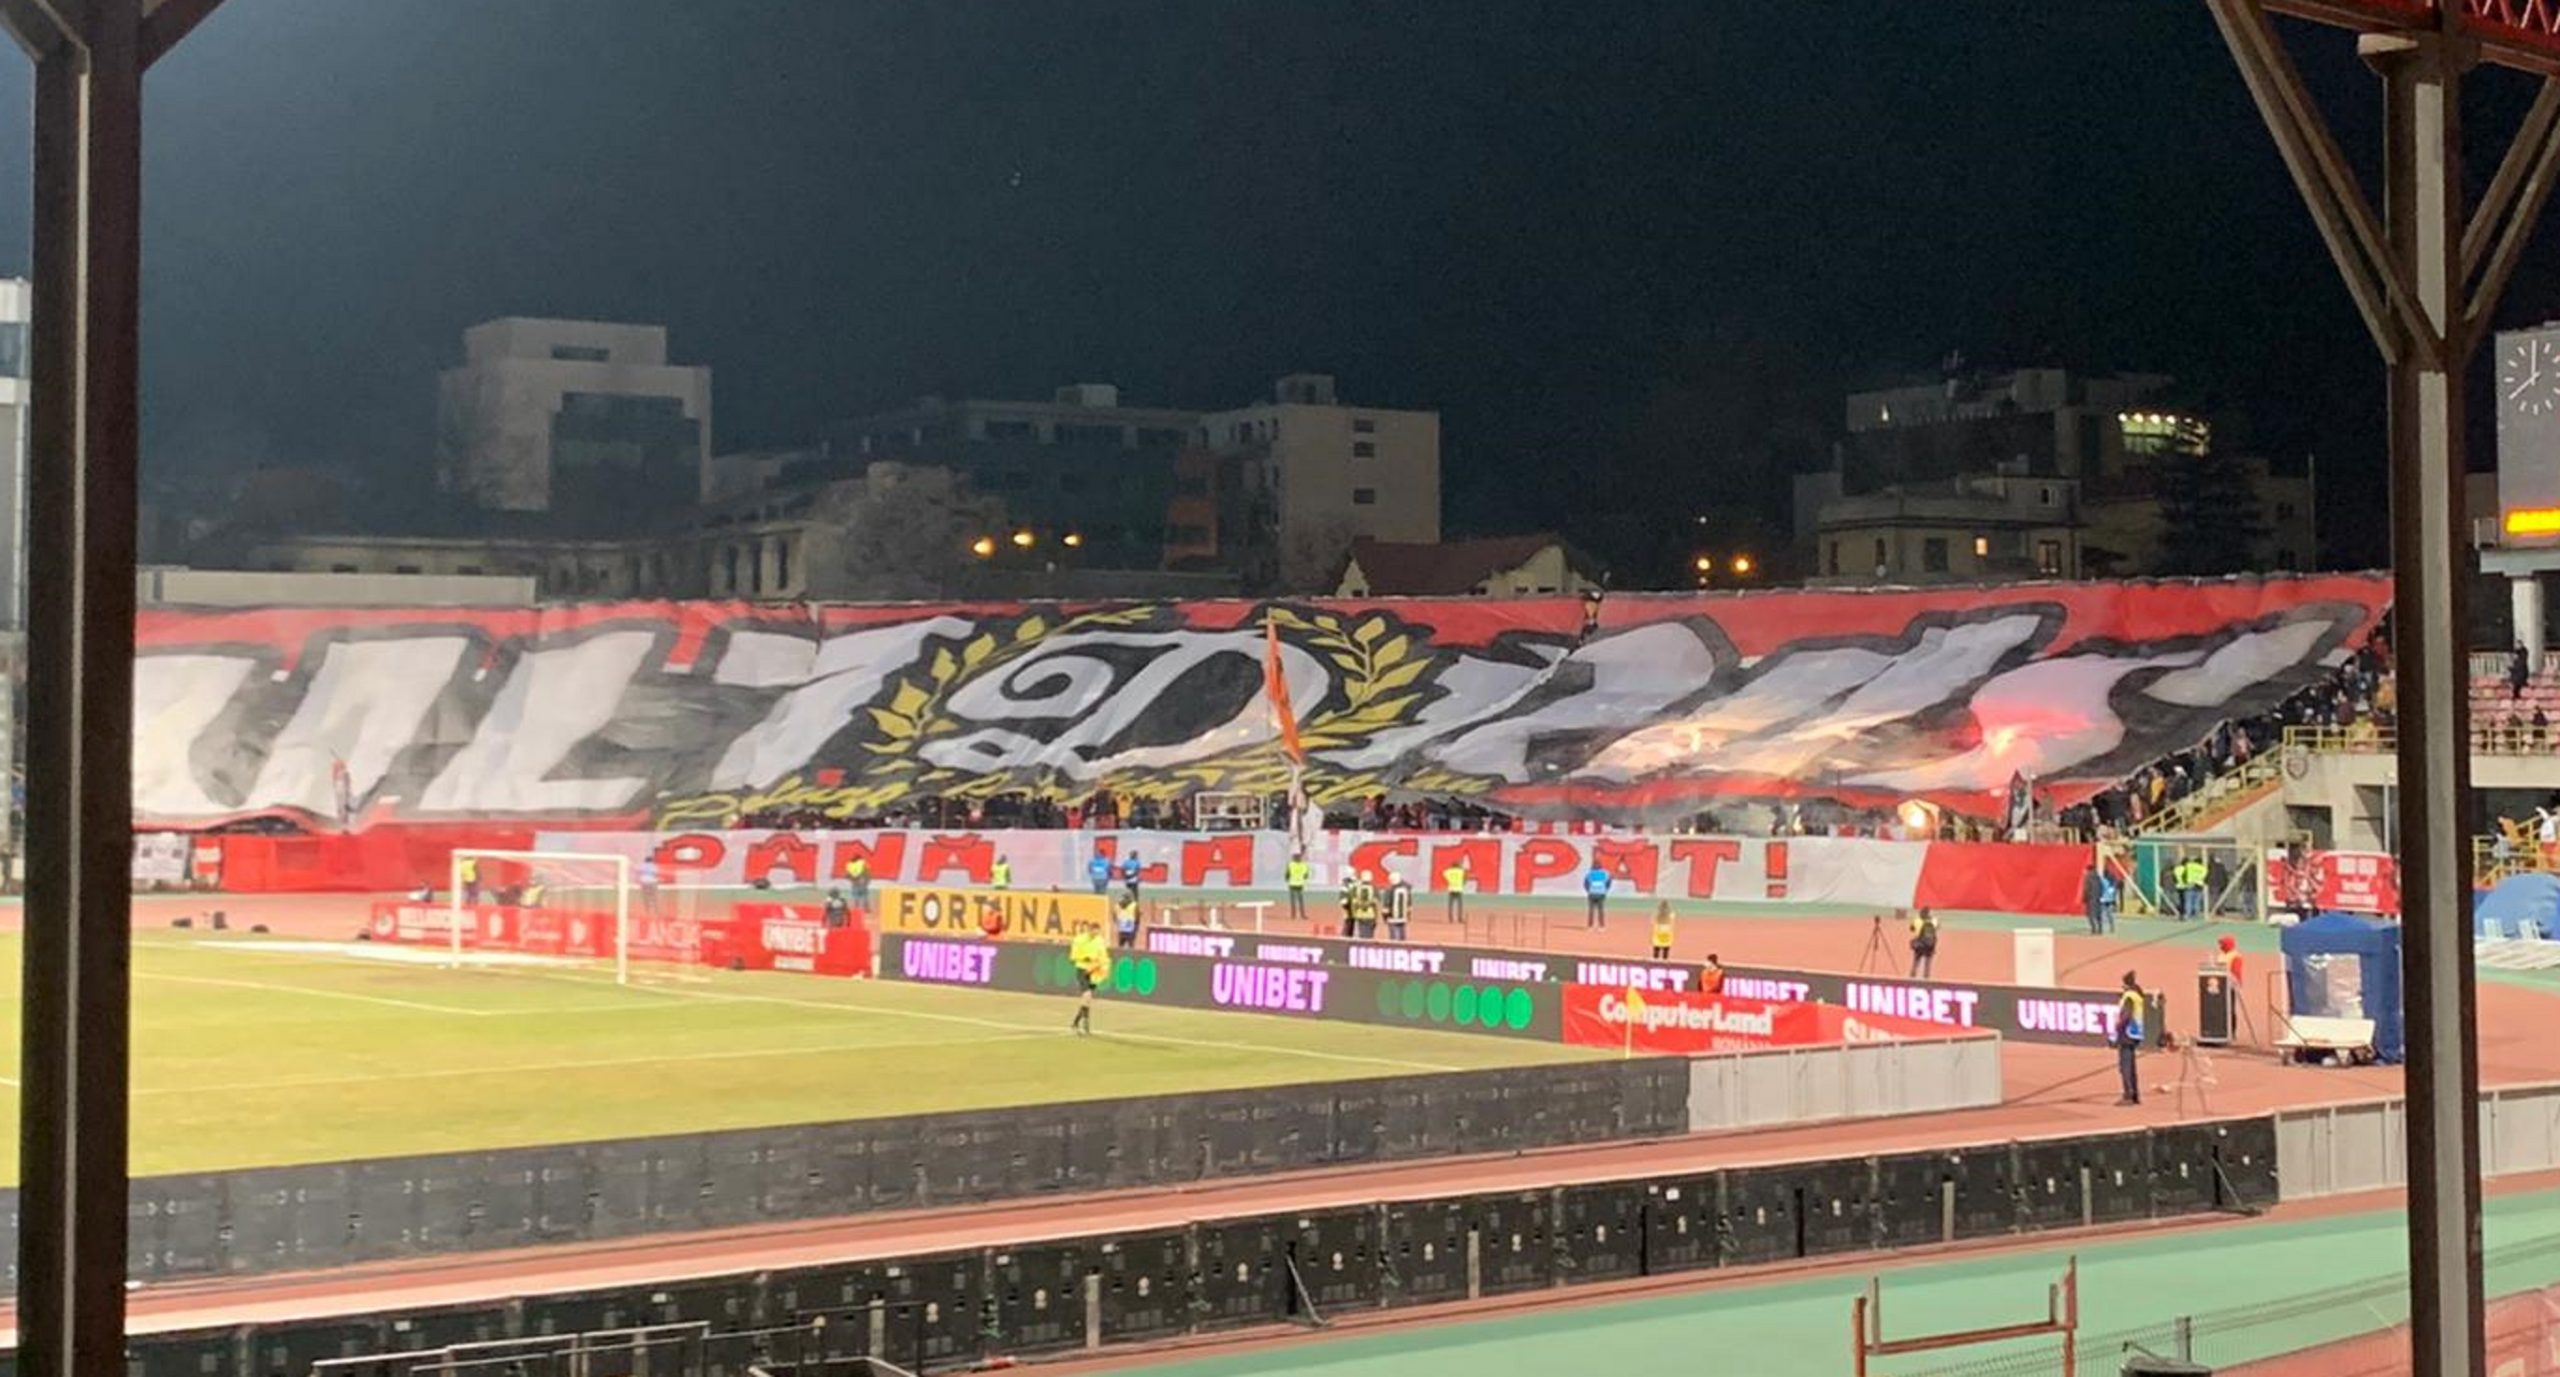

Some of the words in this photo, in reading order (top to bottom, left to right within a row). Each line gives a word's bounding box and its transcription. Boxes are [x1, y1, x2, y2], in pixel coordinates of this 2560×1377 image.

[1097, 834, 1255, 886] LA
[762, 921, 829, 954] UNIBET
[903, 940, 998, 983] UNIBET
[1211, 962, 1330, 1012] UNIBET
[1846, 983, 1979, 1028] UNIBET
[2016, 998, 2120, 1036] UNIBET
